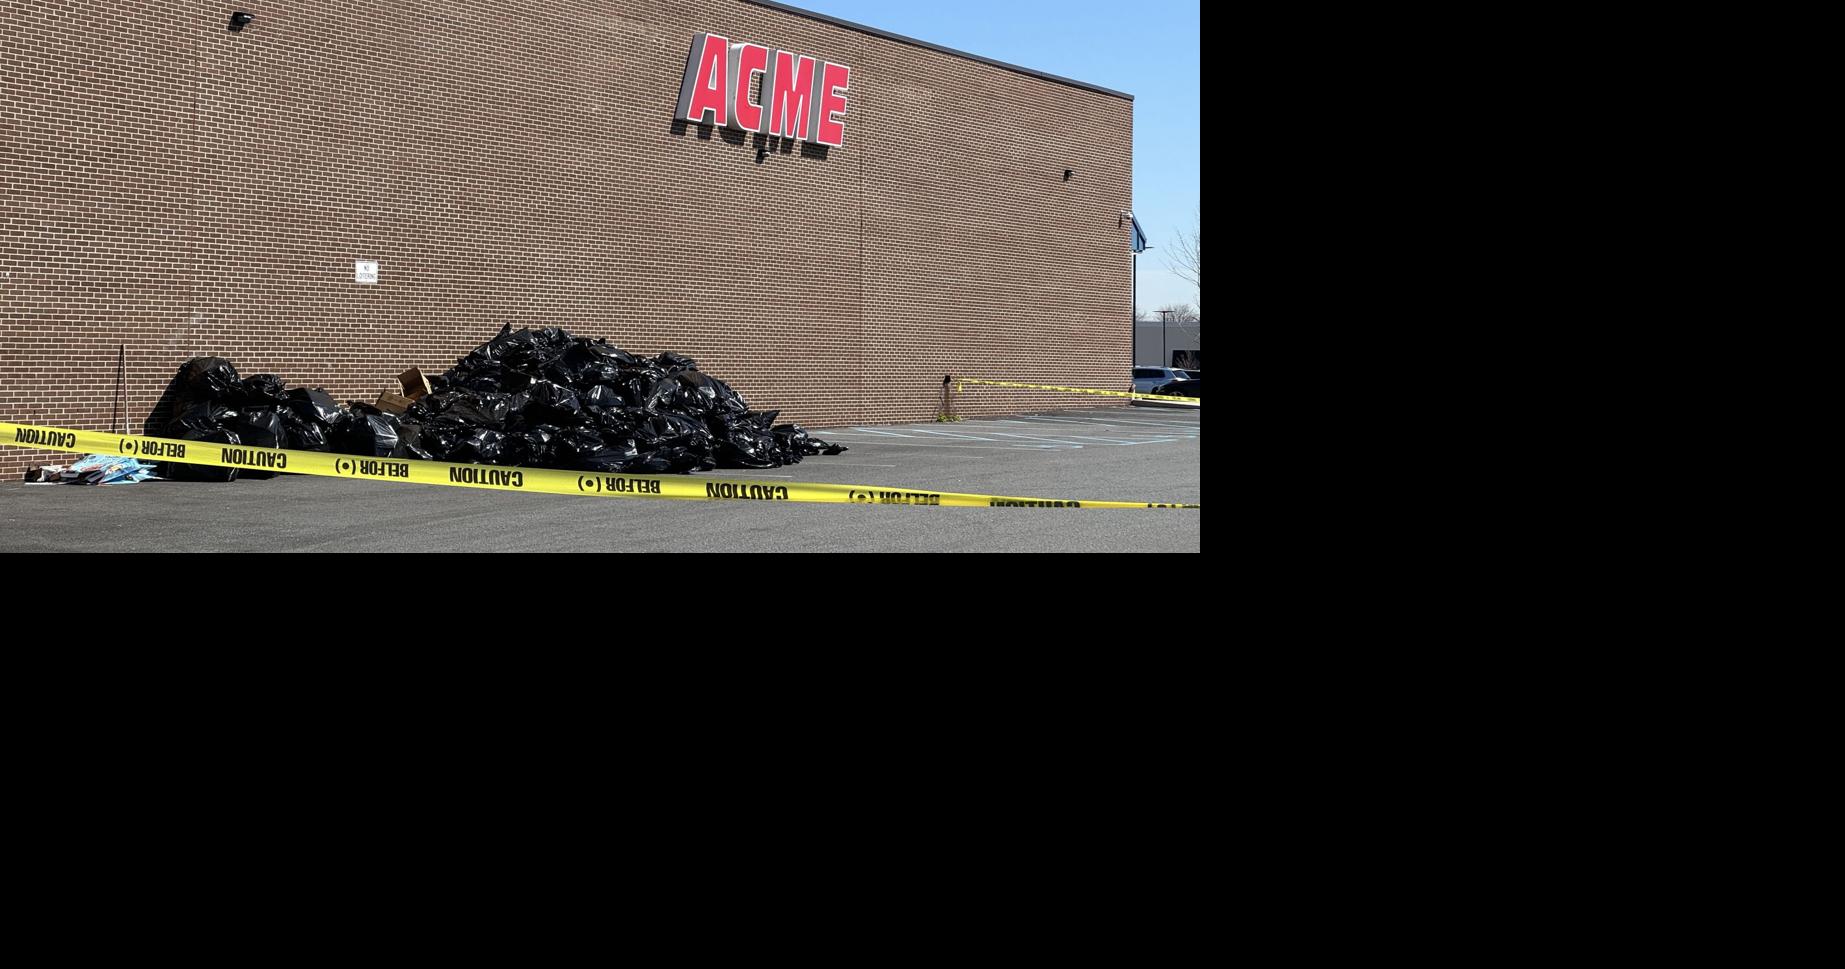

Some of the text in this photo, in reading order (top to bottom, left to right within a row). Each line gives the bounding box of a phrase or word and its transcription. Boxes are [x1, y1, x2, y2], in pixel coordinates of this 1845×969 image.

[686, 33, 850, 147] ACME
[15, 427, 76, 448] CAUTION
[141, 440, 185, 458] BELFOR
[221, 447, 287, 469] CAUTION
[360, 460, 409, 478] BELFOR
[450, 467, 524, 487] CAUTION
[606, 477, 661, 494] BELFOR
[706, 482, 789, 500] CAUTION
